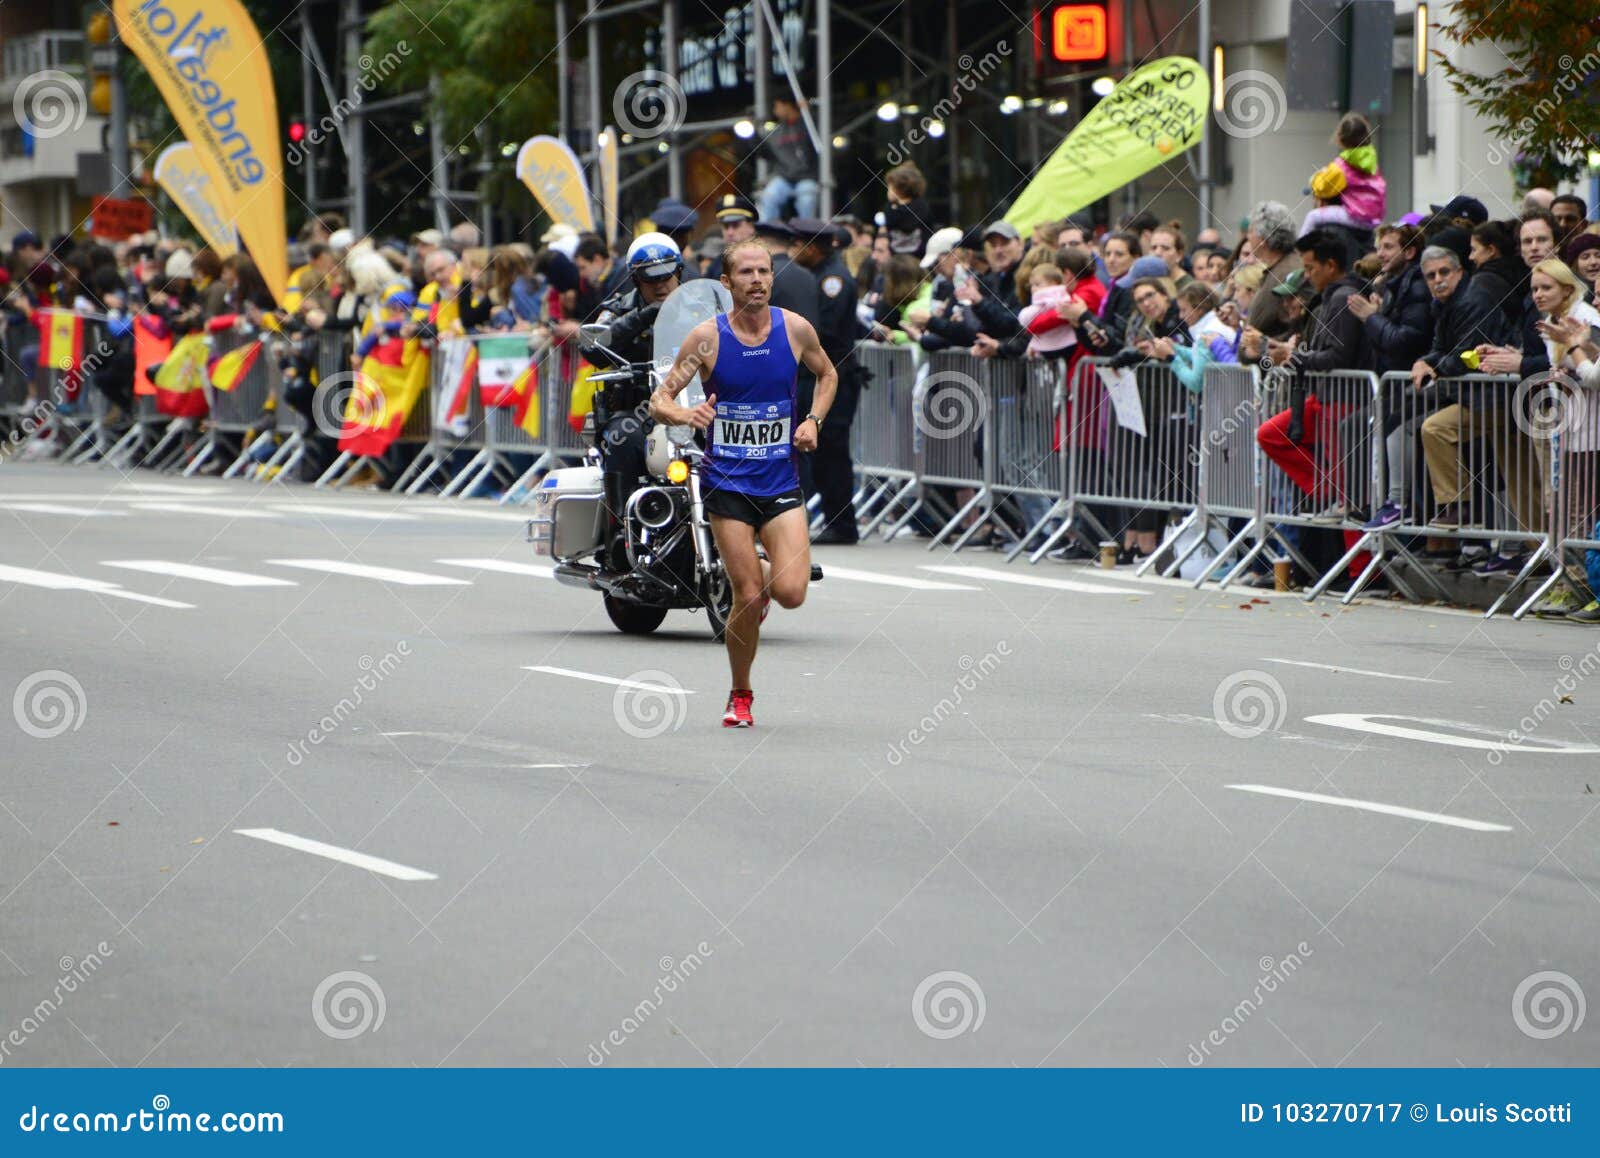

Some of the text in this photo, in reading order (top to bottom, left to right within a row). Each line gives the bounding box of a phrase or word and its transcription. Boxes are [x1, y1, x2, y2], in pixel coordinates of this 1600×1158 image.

[1161, 63, 1196, 91] GO
[1112, 88, 1194, 145] STEPHEN
[742, 348, 770, 357] saucony
[722, 421, 783, 446] WARD
[746, 448, 768, 457] 2017
